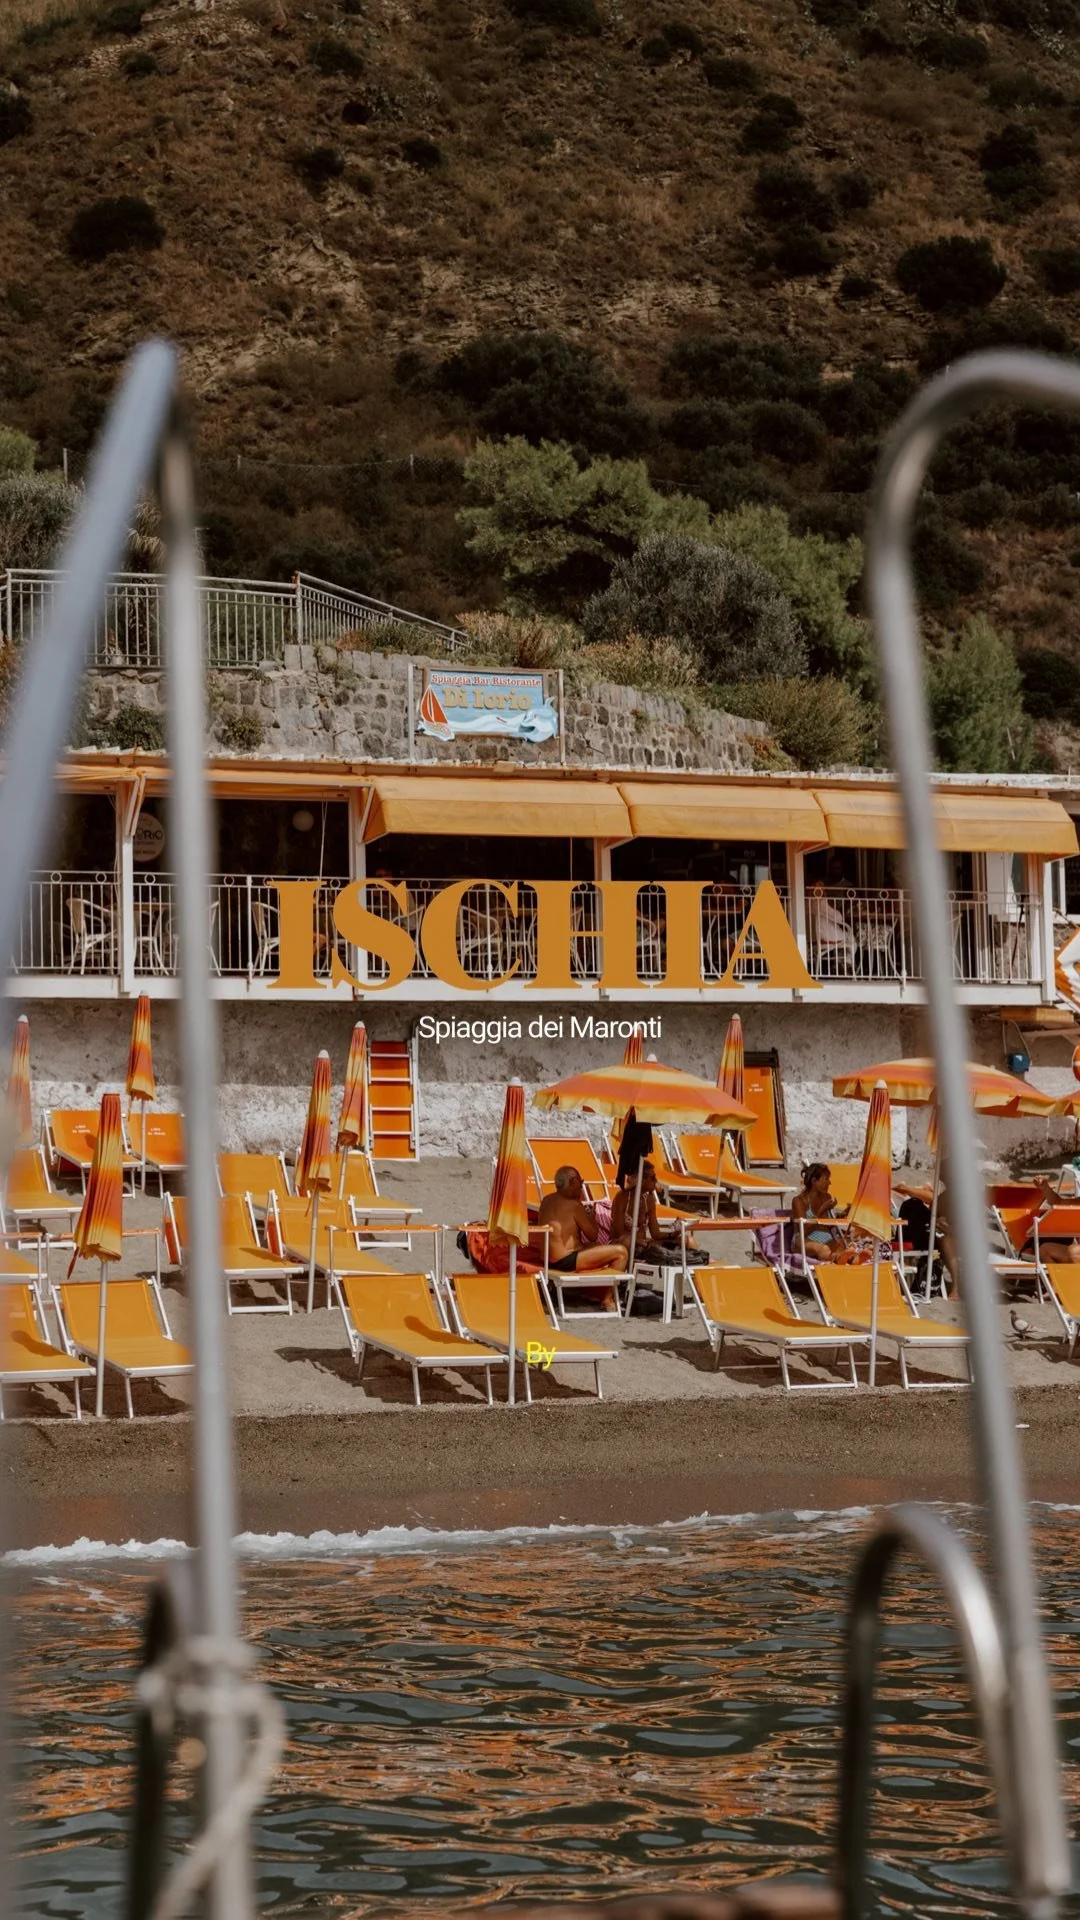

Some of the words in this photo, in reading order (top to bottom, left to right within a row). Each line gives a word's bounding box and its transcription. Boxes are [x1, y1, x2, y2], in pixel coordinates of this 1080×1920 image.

[432, 674, 471, 686] Spiaggia
[473, 676, 490, 685] Bar
[492, 676, 541, 686] Ristorante
[443, 687, 467, 708] Di
[472, 688, 531, 710] Iorio
